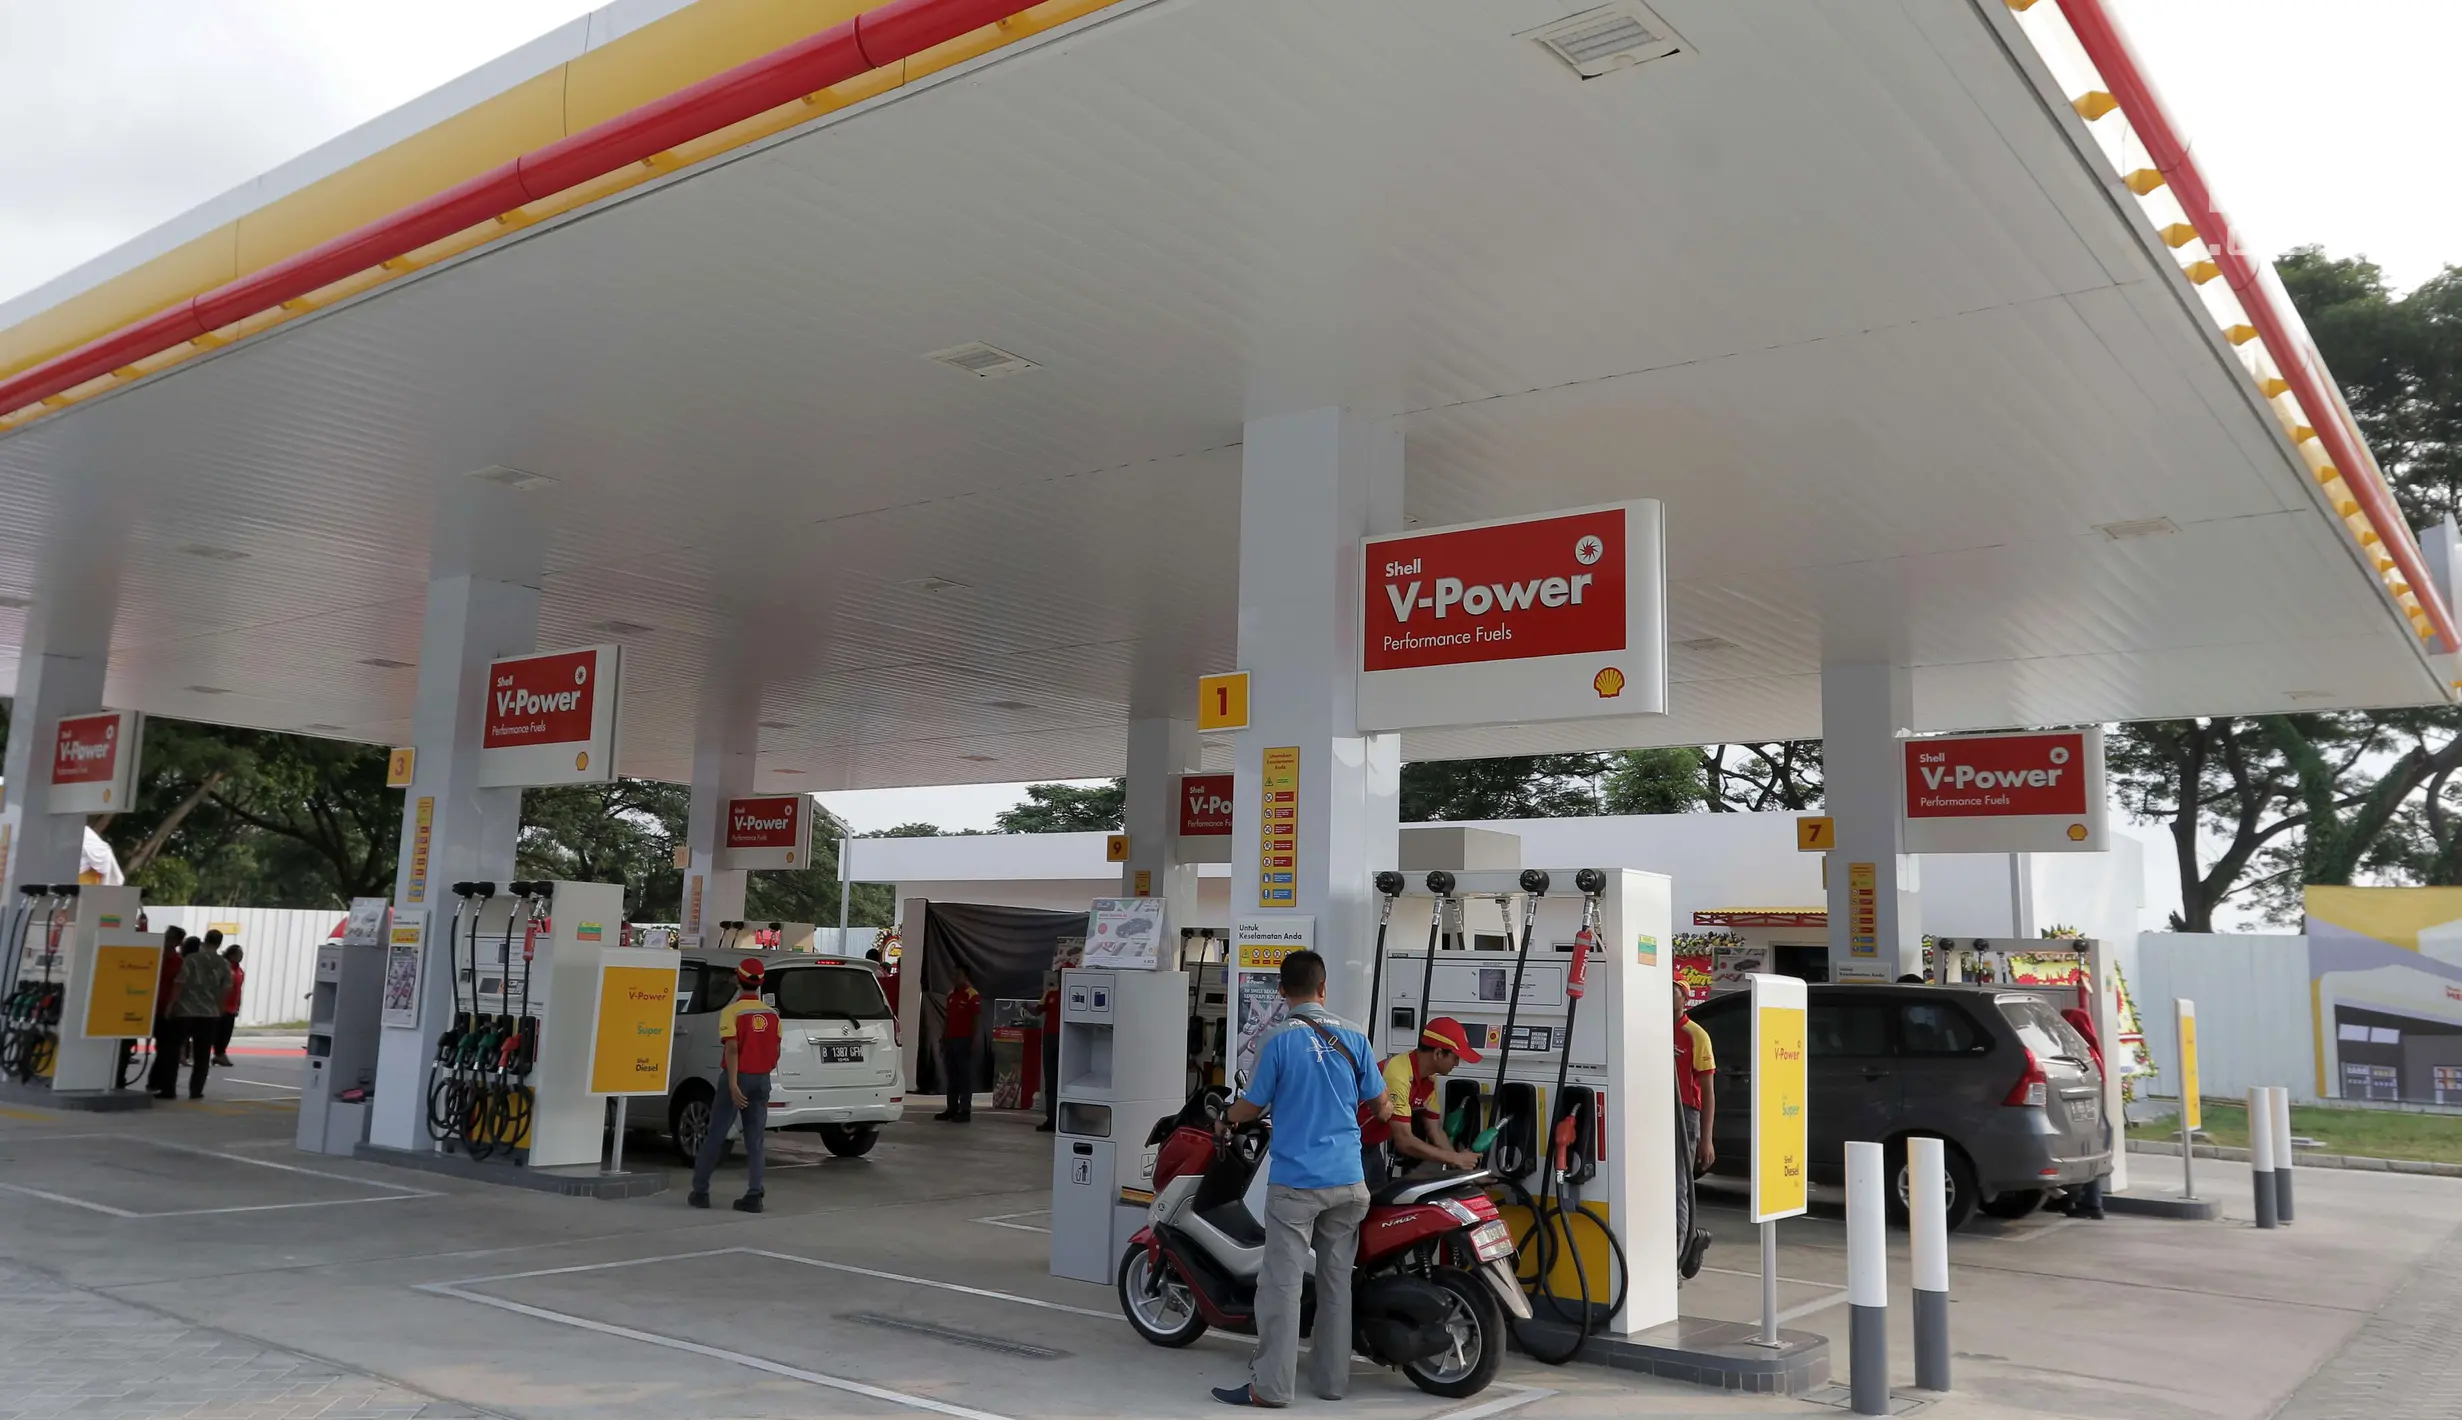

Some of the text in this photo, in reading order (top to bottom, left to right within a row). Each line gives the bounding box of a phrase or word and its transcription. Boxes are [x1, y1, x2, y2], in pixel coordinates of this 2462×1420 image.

[1385, 558, 1422, 578] Shell
[1385, 572, 1592, 624] V-Power
[1382, 622, 1513, 652] Performance Fuels
[497, 676, 513, 687] Shell
[496, 688, 581, 717] V-Power
[1216, 686, 1228, 716] 1
[491, 720, 546, 736] Performance Fuels
[61, 741, 109, 761] V-Power
[1919, 752, 1946, 764] Shell
[394, 757, 405, 777] 3
[1920, 765, 2062, 790] V-Power
[1189, 786, 1205, 794] Shell
[1189, 796, 1233, 815] V-Po
[1920, 794, 2010, 807] Performance Fuels
[734, 815, 789, 831] V-Power
[1187, 819, 1224, 828] Performance
[1807, 824, 1823, 843] 7
[1112, 841, 1122, 855] 9
[1239, 924, 1260, 932] Untuk
[1238, 932, 1303, 940] Keselamatan Anda
[628, 991, 667, 1001] V-Power
[637, 1026, 662, 1036] Super
[822, 1047, 828, 1058] B
[1774, 1047, 1801, 1060] V-Power
[635, 1063, 659, 1072] Diesel
[1782, 1103, 1799, 1119] Super
[1784, 1164, 1800, 1178] Diesel
[1381, 1213, 1419, 1229] NMAX
